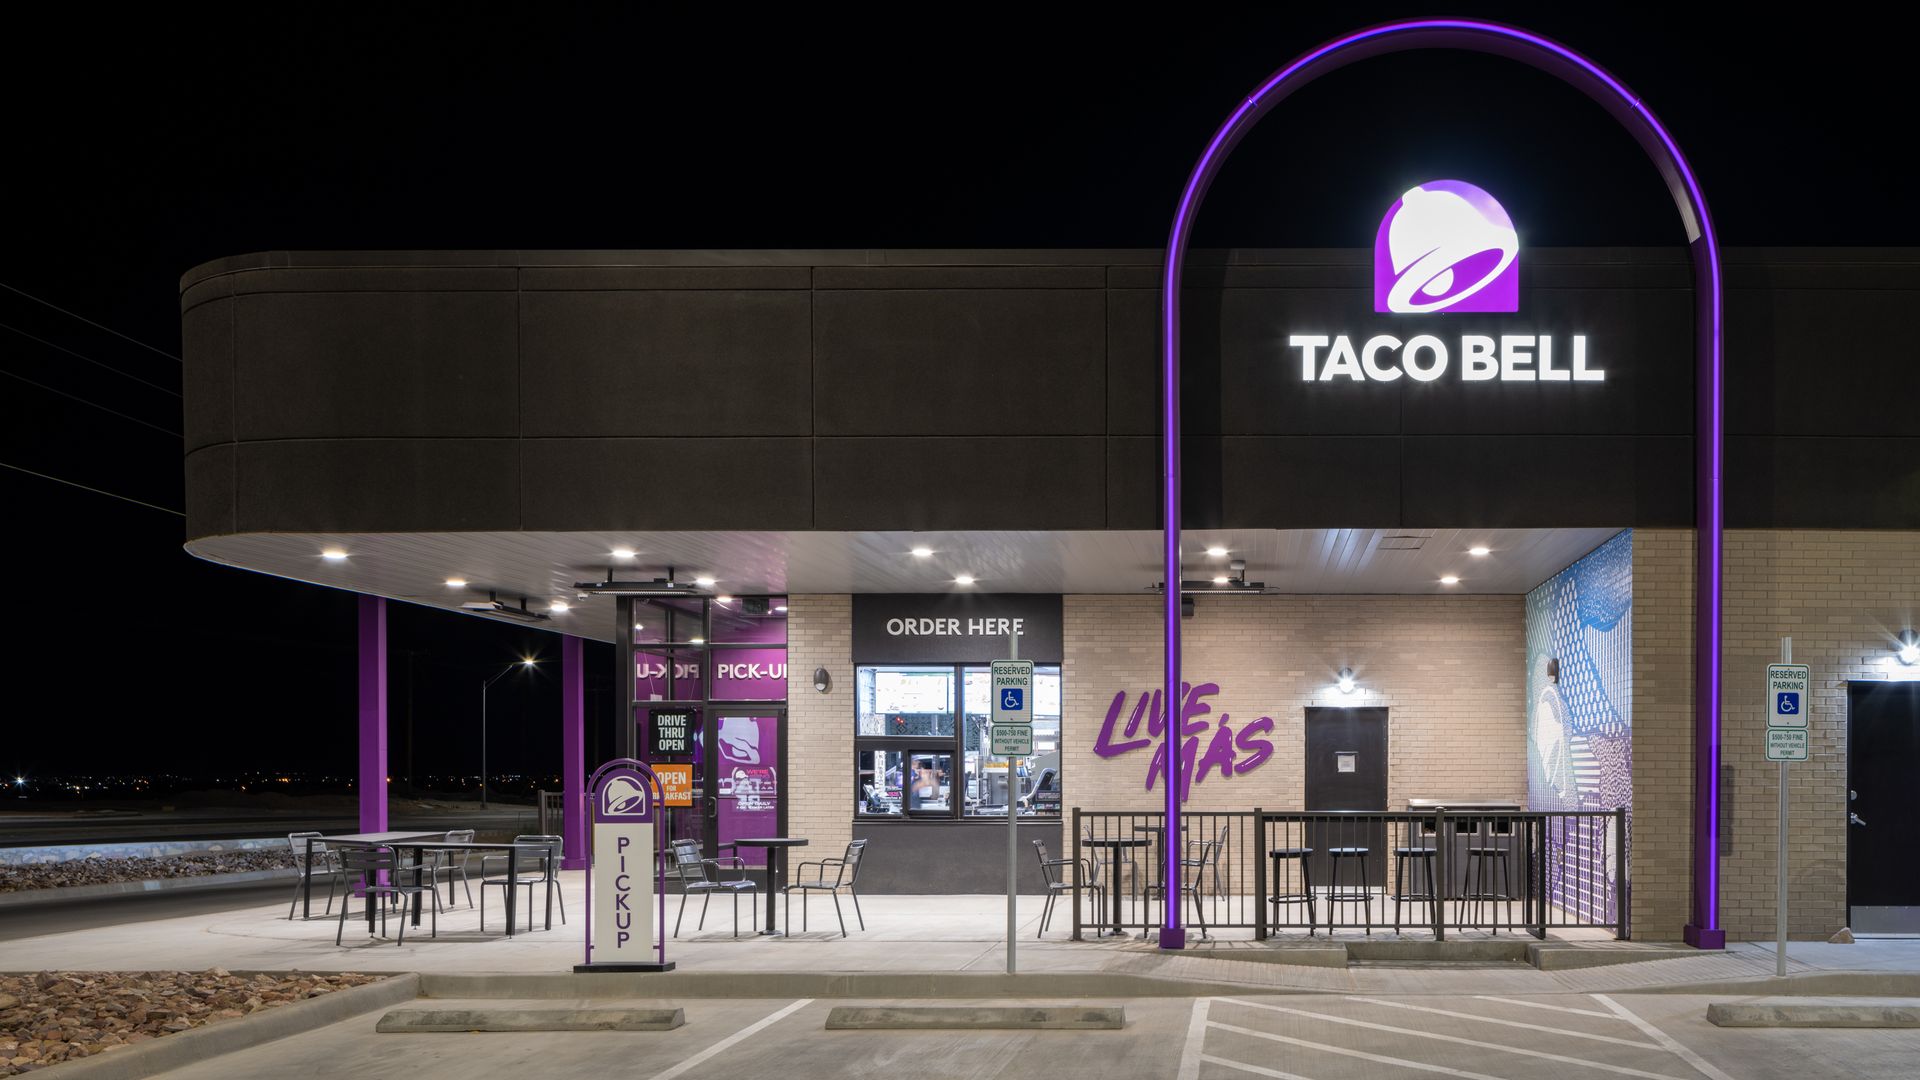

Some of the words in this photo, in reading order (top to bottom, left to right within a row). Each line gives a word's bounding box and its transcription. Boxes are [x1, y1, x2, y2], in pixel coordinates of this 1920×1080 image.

[1290, 334, 1449, 382] TACO
[1462, 335, 1605, 381] BELL
[886, 618, 962, 636] ORDER
[968, 618, 1024, 636] HERE
[717, 663, 787, 679] PICK-U
[993, 666, 1031, 675] RESERVED
[1770, 670, 1807, 679] RESERVED
[996, 677, 1028, 686] PARKING
[1772, 681, 1804, 690] PARKING
[657, 715, 687, 726] DRIVE
[658, 727, 685, 738] THRU
[1017, 729, 1028, 737] FINE
[1792, 733, 1804, 741] FINE
[659, 739, 685, 751] OPEN
[657, 772, 687, 785] OPEN
[652, 791, 691, 801] BRAKFAST
[615, 836, 632, 949] PICKUP
